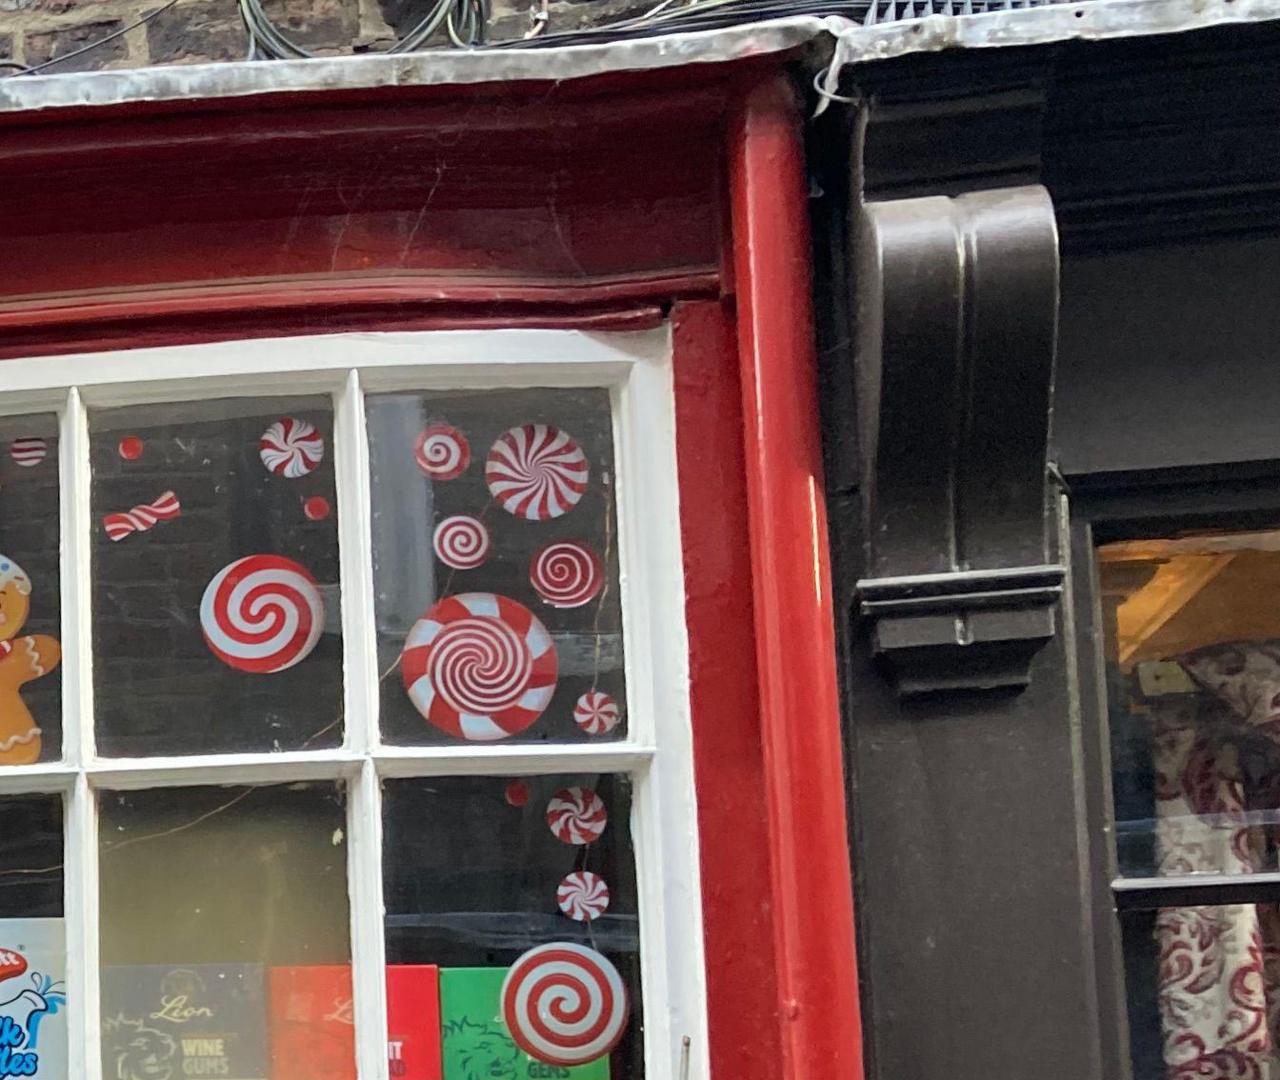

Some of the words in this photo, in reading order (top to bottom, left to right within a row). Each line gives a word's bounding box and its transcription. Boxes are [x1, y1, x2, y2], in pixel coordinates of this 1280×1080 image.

[149, 995, 213, 1023] Lion
[181, 1038, 225, 1056] WINE
[182, 1057, 230, 1075] GUMS
